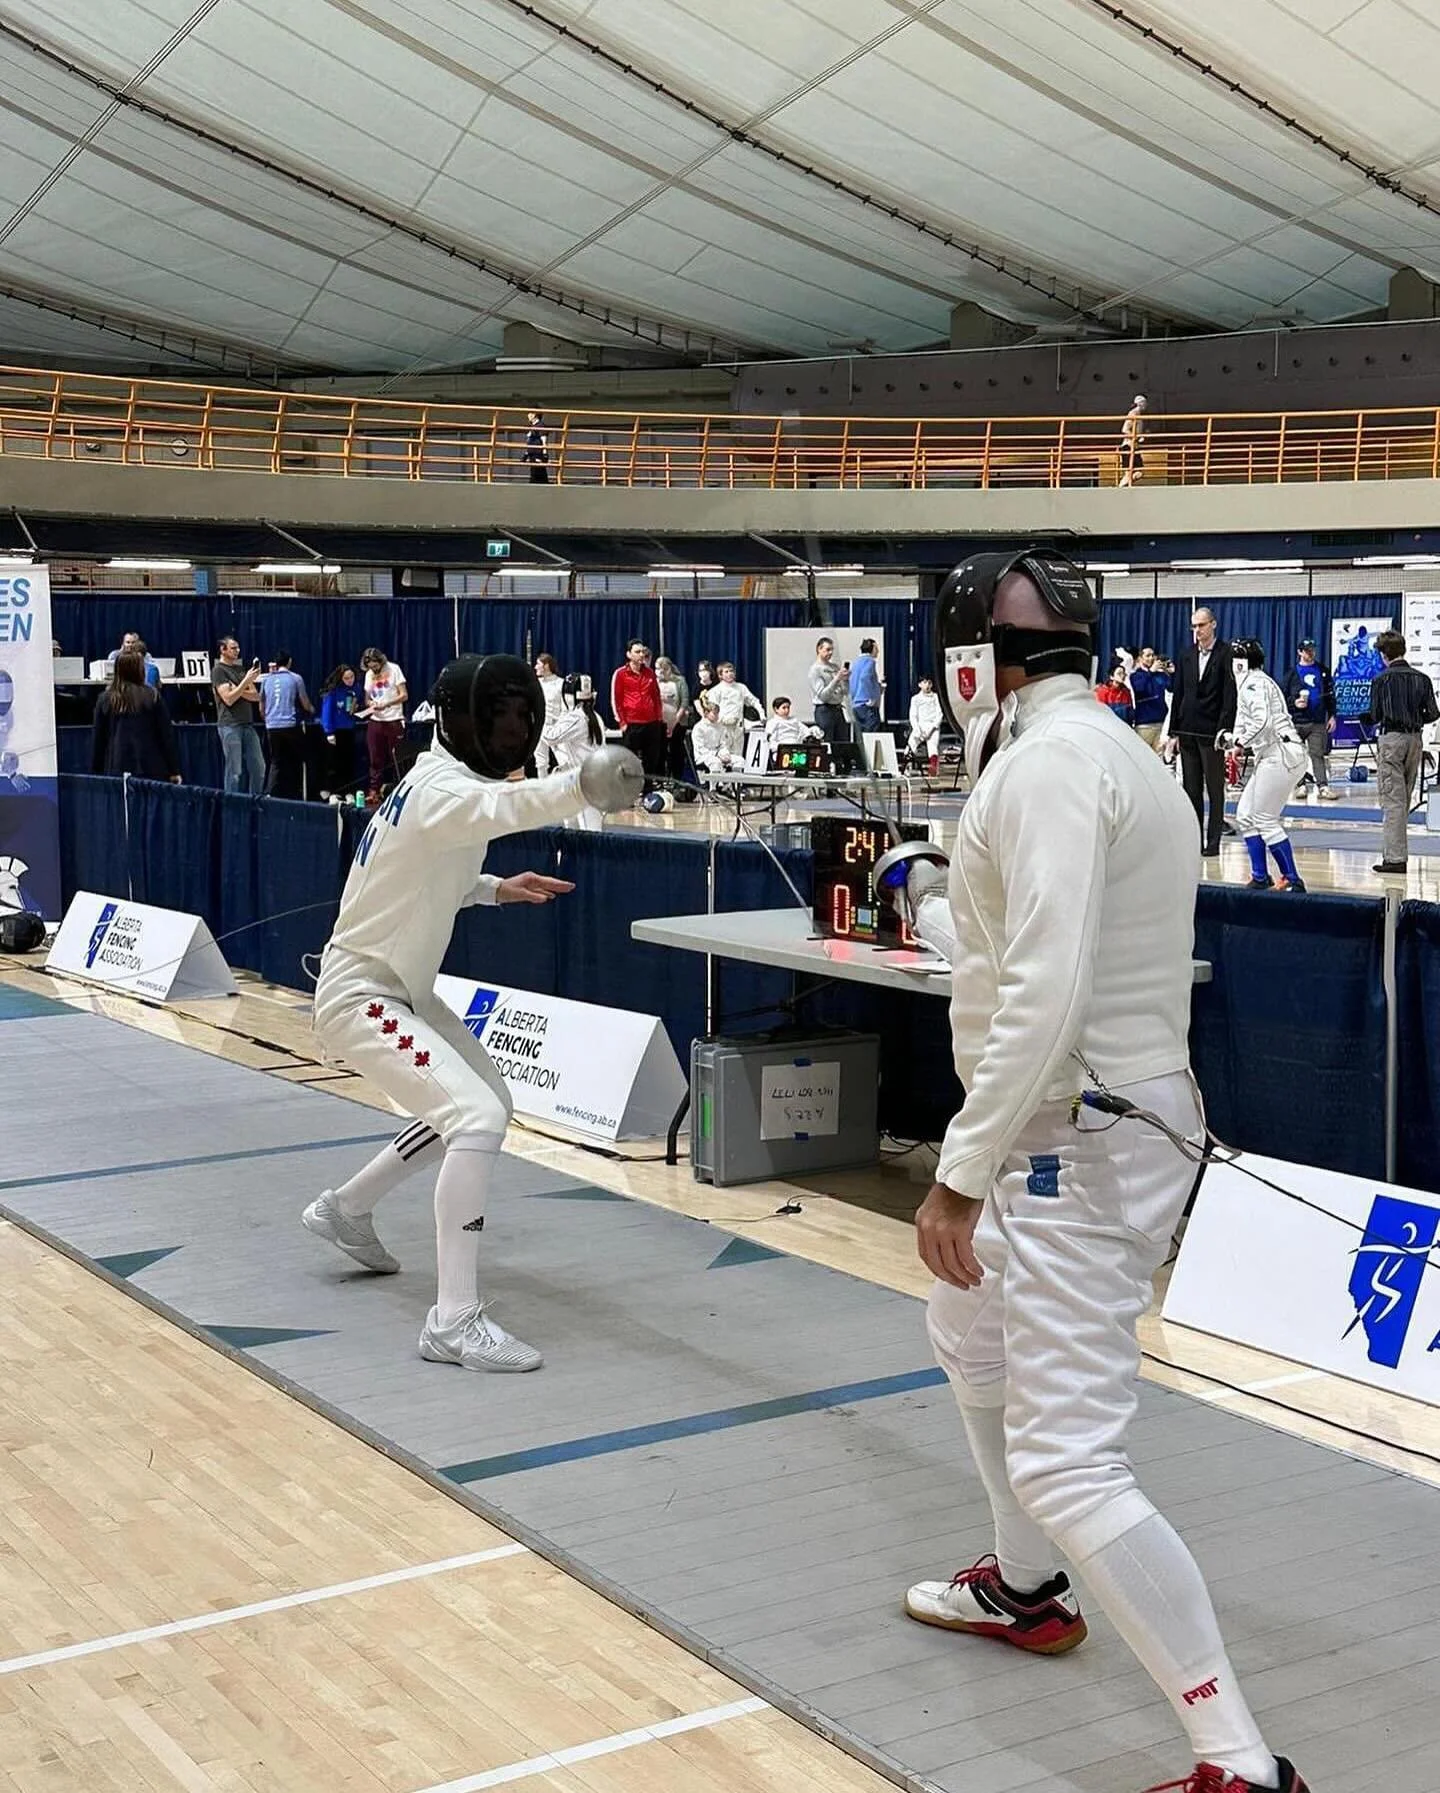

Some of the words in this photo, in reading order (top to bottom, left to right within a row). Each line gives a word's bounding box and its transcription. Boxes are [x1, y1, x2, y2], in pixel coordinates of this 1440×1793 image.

[187, 659, 205, 677] DT
[1335, 686, 1371, 697] FENCI
[751, 739, 761, 767] A
[833, 884, 850, 934] 0
[114, 916, 142, 932] ALBERTA
[107, 932, 137, 951] FENCING
[99, 948, 143, 971] ASSOCIATION
[495, 1008, 548, 1035] ALBERTA
[487, 1030, 543, 1059] FENCING
[490, 1055, 560, 1090] SOCIATION
